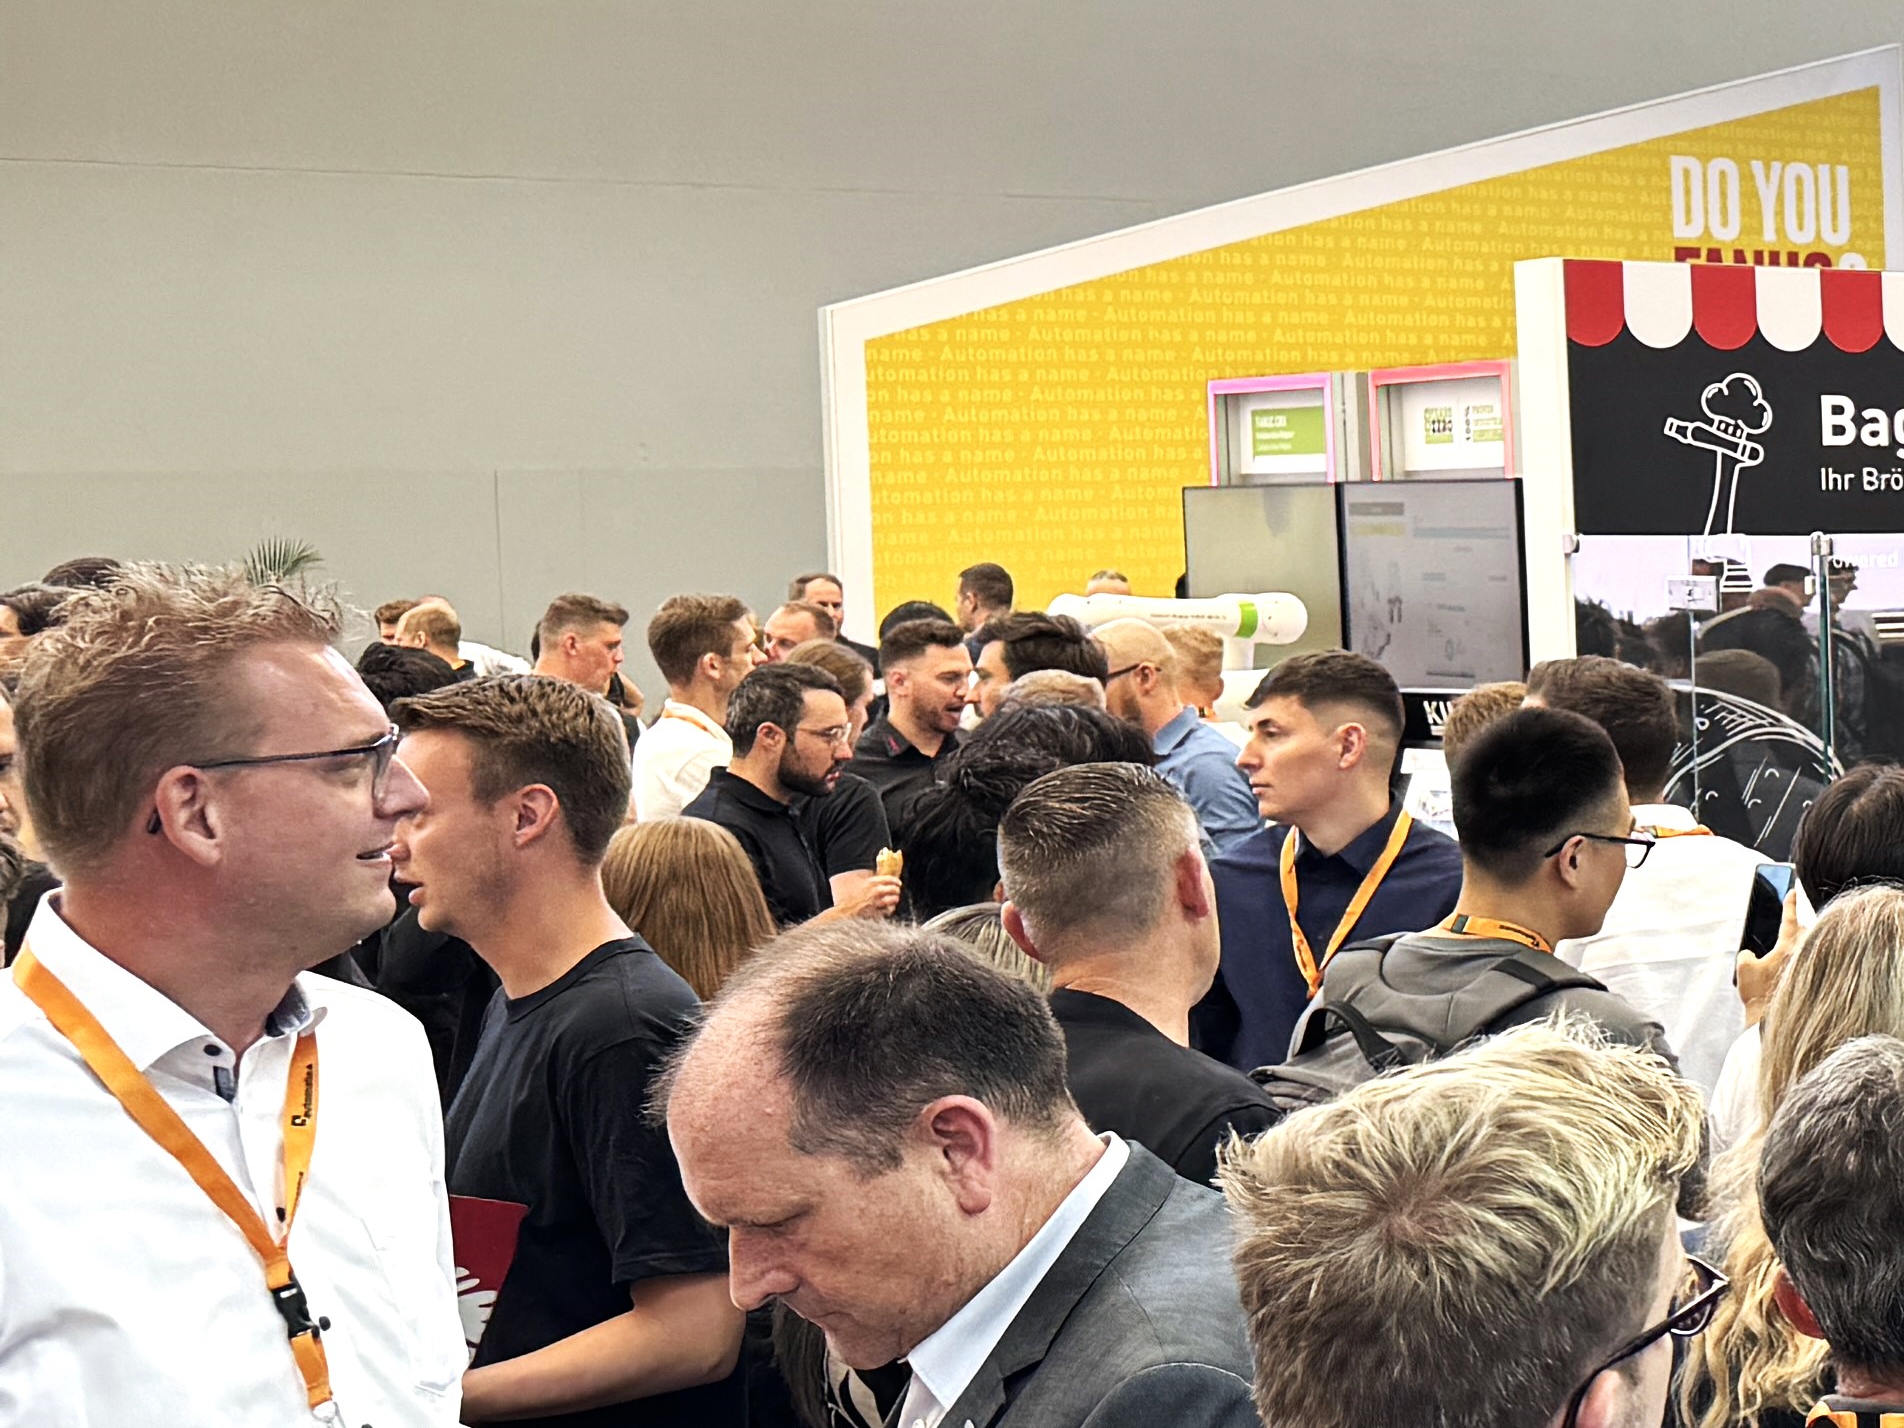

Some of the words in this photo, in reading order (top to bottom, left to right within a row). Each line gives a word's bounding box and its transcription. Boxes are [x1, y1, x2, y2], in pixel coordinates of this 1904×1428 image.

[1670, 154, 1740, 241] DO
[1750, 159, 1851, 246] YOU
[1422, 237, 1523, 253] Automation
[1343, 253, 1446, 269] Automation
[1271, 270, 1378, 287] Automation
[1189, 289, 1298, 305] Automation
[1104, 307, 1216, 323] Automation
[1344, 310, 1449, 326] Automation
[1028, 327, 1142, 343] Automation
[1273, 328, 1380, 344] Automation
[940, 347, 1057, 363] Automation
[1192, 347, 1300, 362] Automation
[1030, 386, 1143, 401] Automation
[943, 407, 1060, 422] Automation
[1033, 446, 1147, 462] Automation
[945, 467, 1055, 483] Automation
[1820, 468, 1855, 491] Ihr
[1831, 551, 1898, 569] owered
